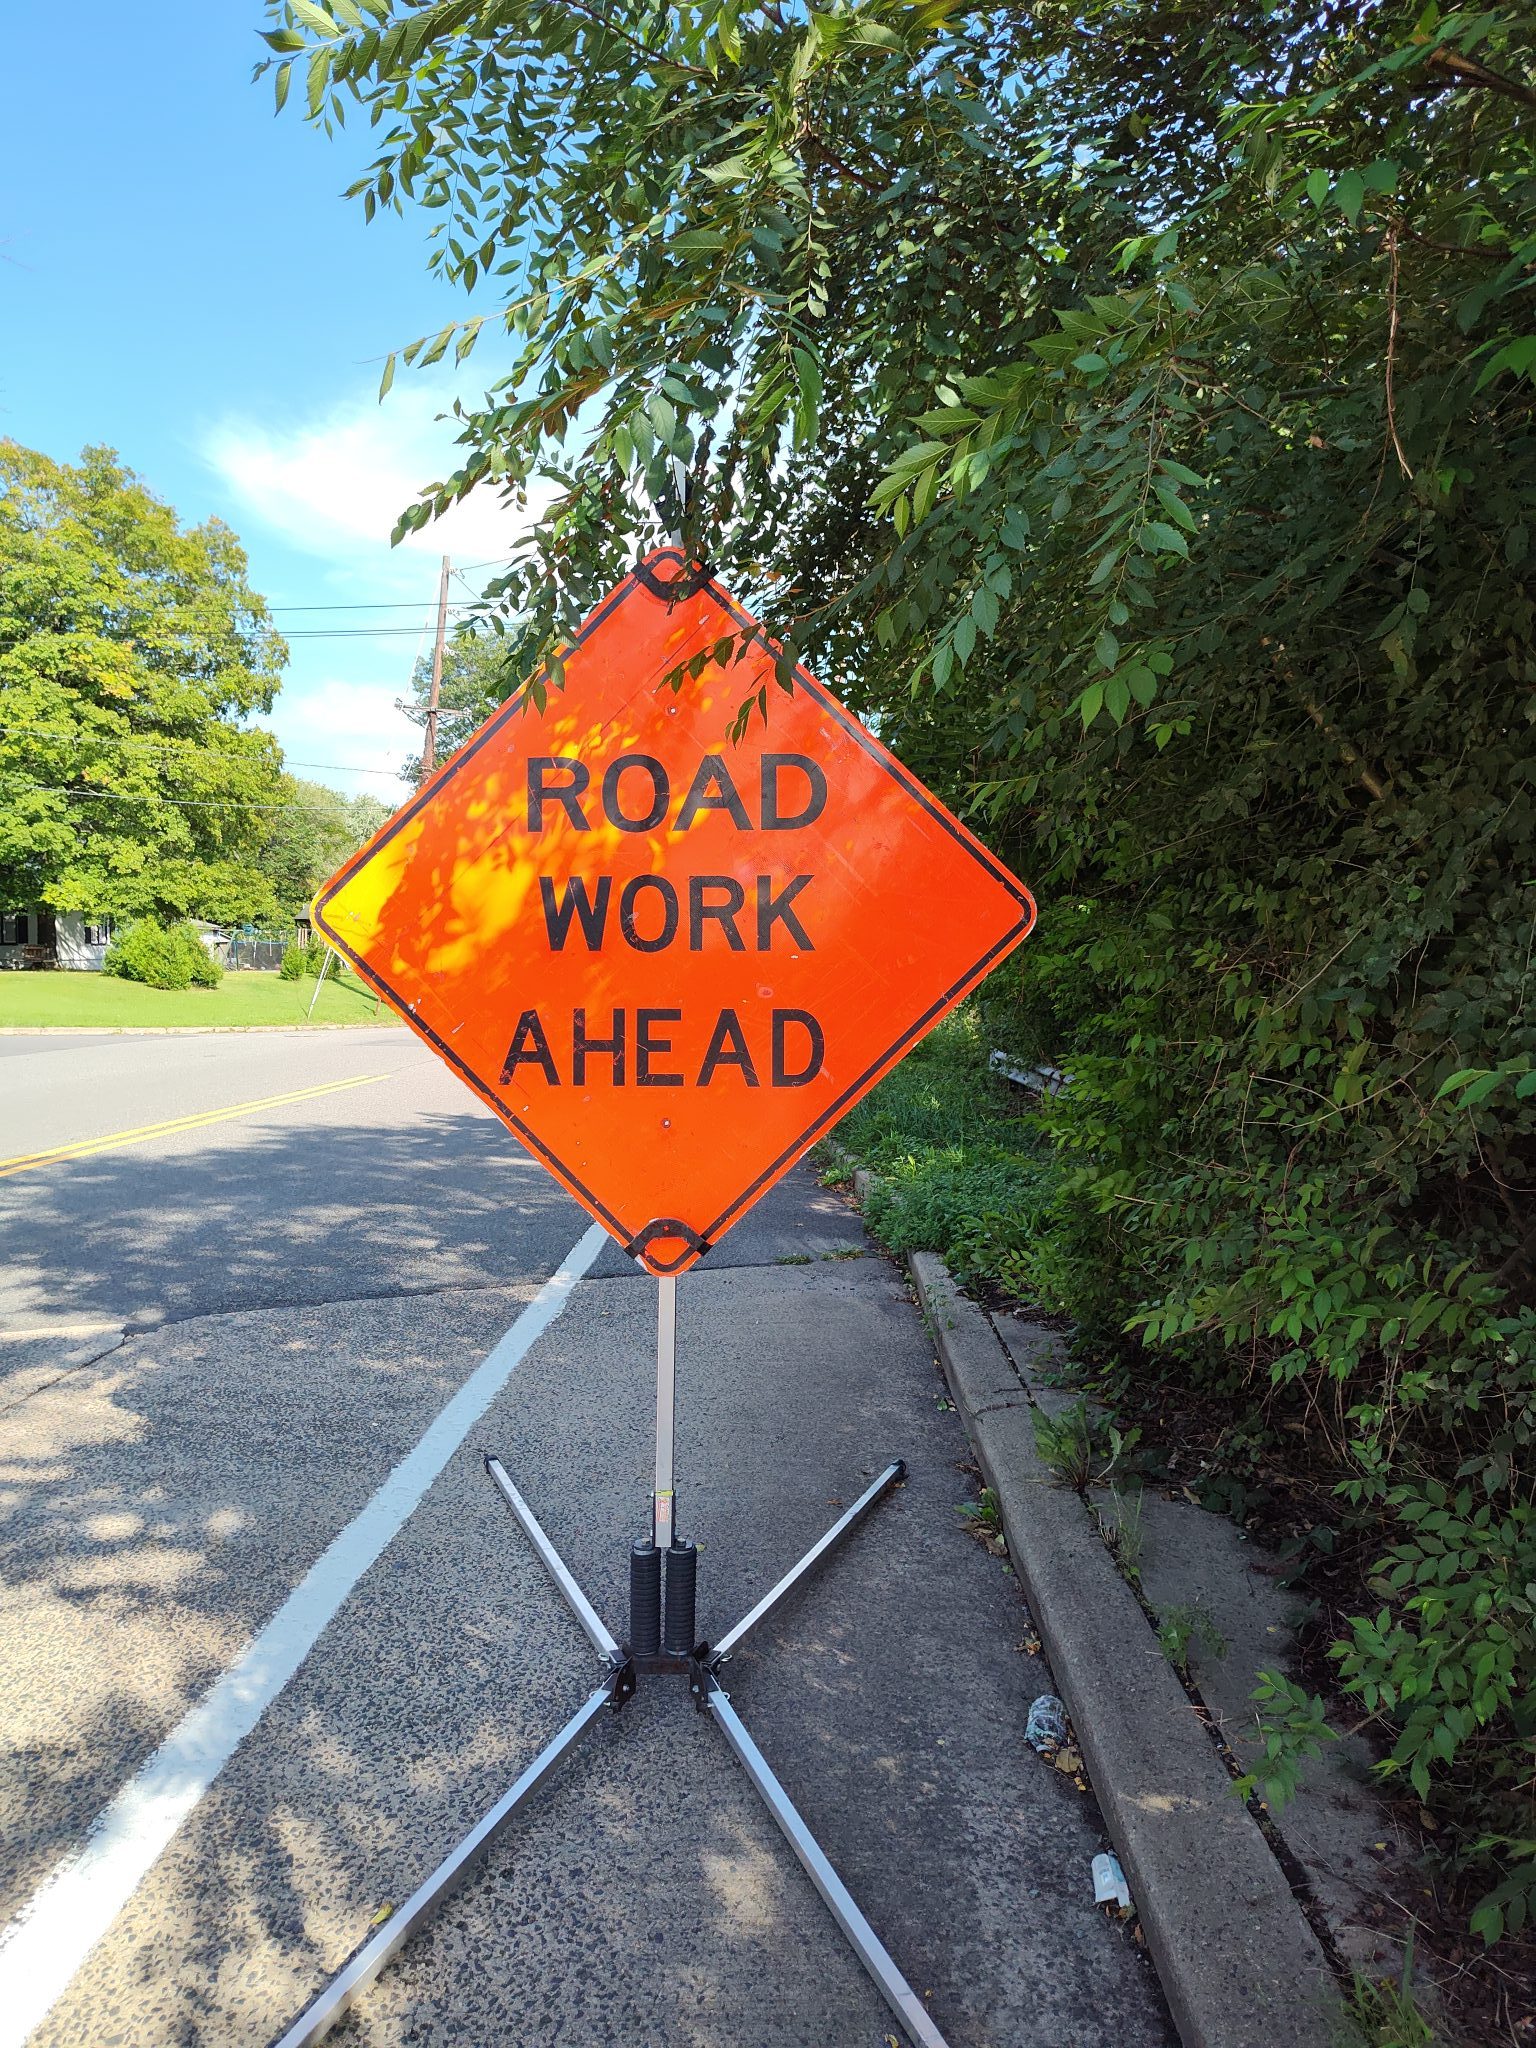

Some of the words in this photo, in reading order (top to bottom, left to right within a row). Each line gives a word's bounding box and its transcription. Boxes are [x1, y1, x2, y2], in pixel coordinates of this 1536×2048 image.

[527, 753, 828, 833] ROAD
[539, 874, 815, 952] WORK
[499, 1008, 826, 1087] AHEAD
